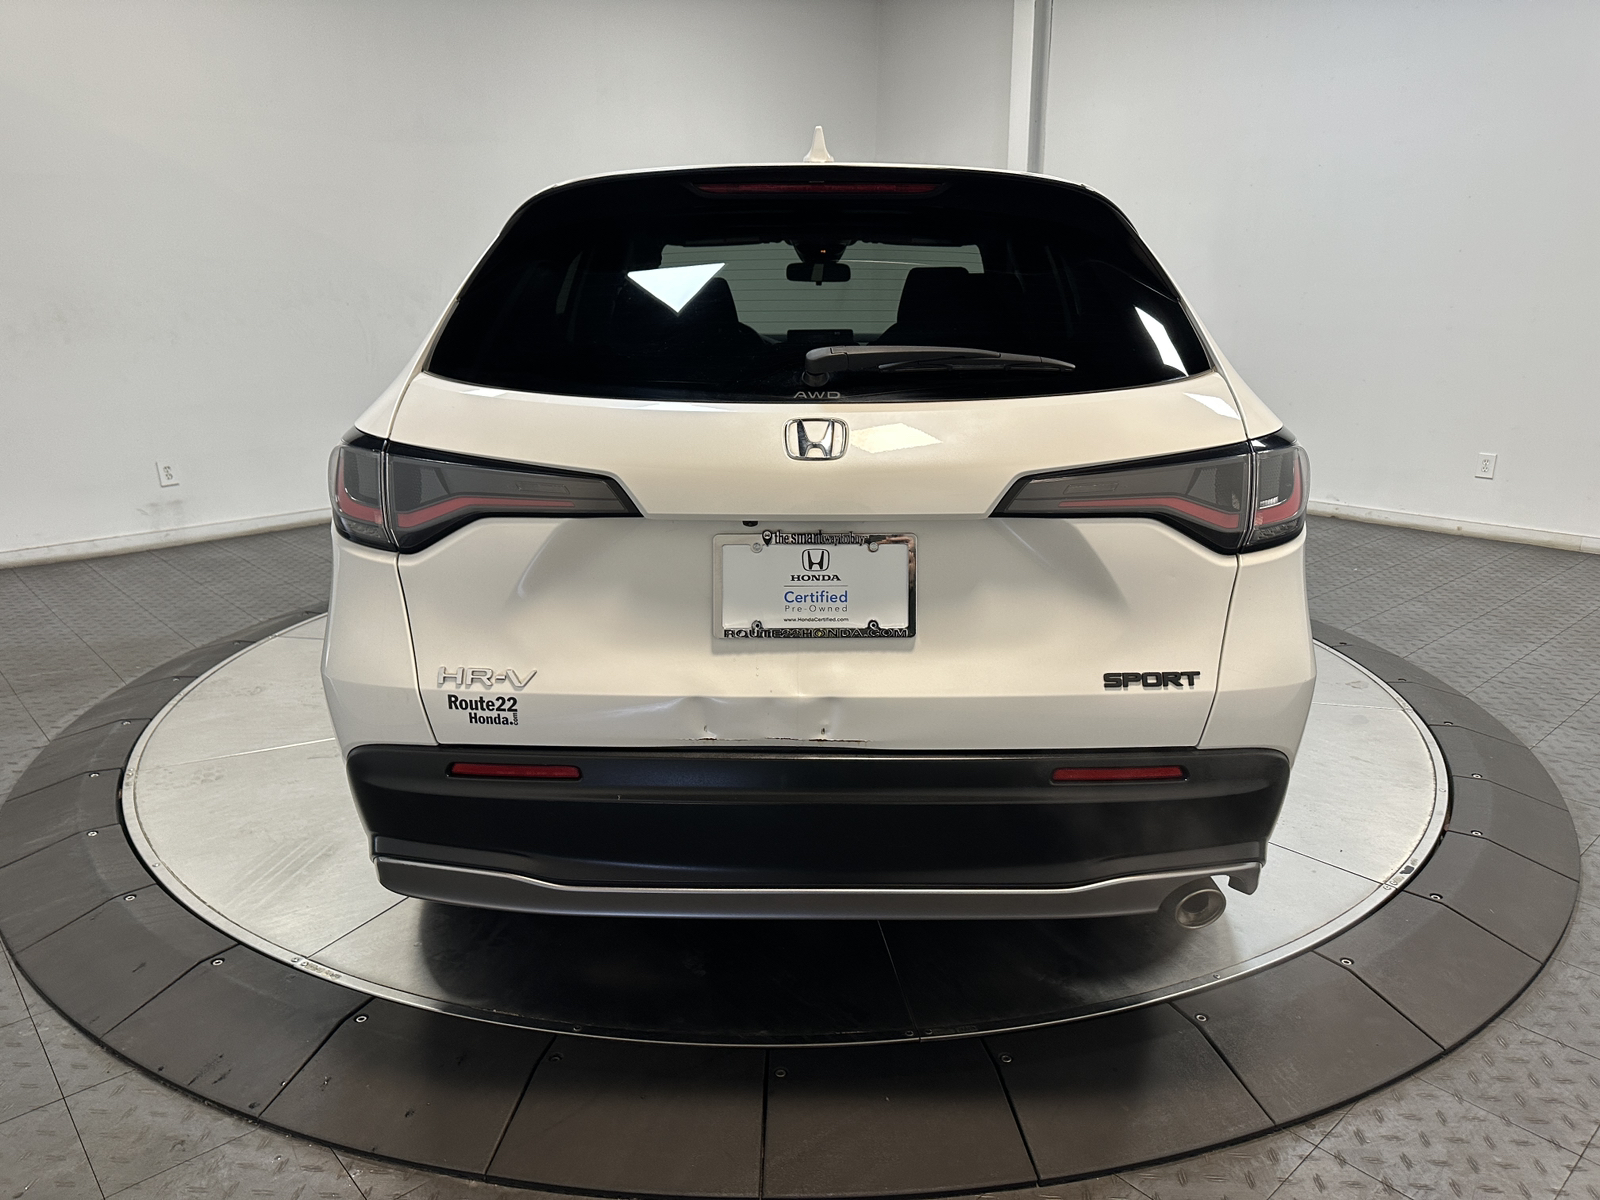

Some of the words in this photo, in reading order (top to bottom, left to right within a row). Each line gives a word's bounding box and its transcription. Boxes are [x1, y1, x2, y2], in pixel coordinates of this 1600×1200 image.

[793, 391, 841, 399] AWD
[775, 529, 789, 544] the
[791, 529, 823, 545] smart
[790, 574, 841, 582] HONDA
[784, 590, 848, 604] Certified
[784, 605, 848, 613] Pre-Owned
[437, 666, 538, 688] HR-V
[1103, 671, 1201, 688] SPORT
[447, 694, 518, 712] Route22
